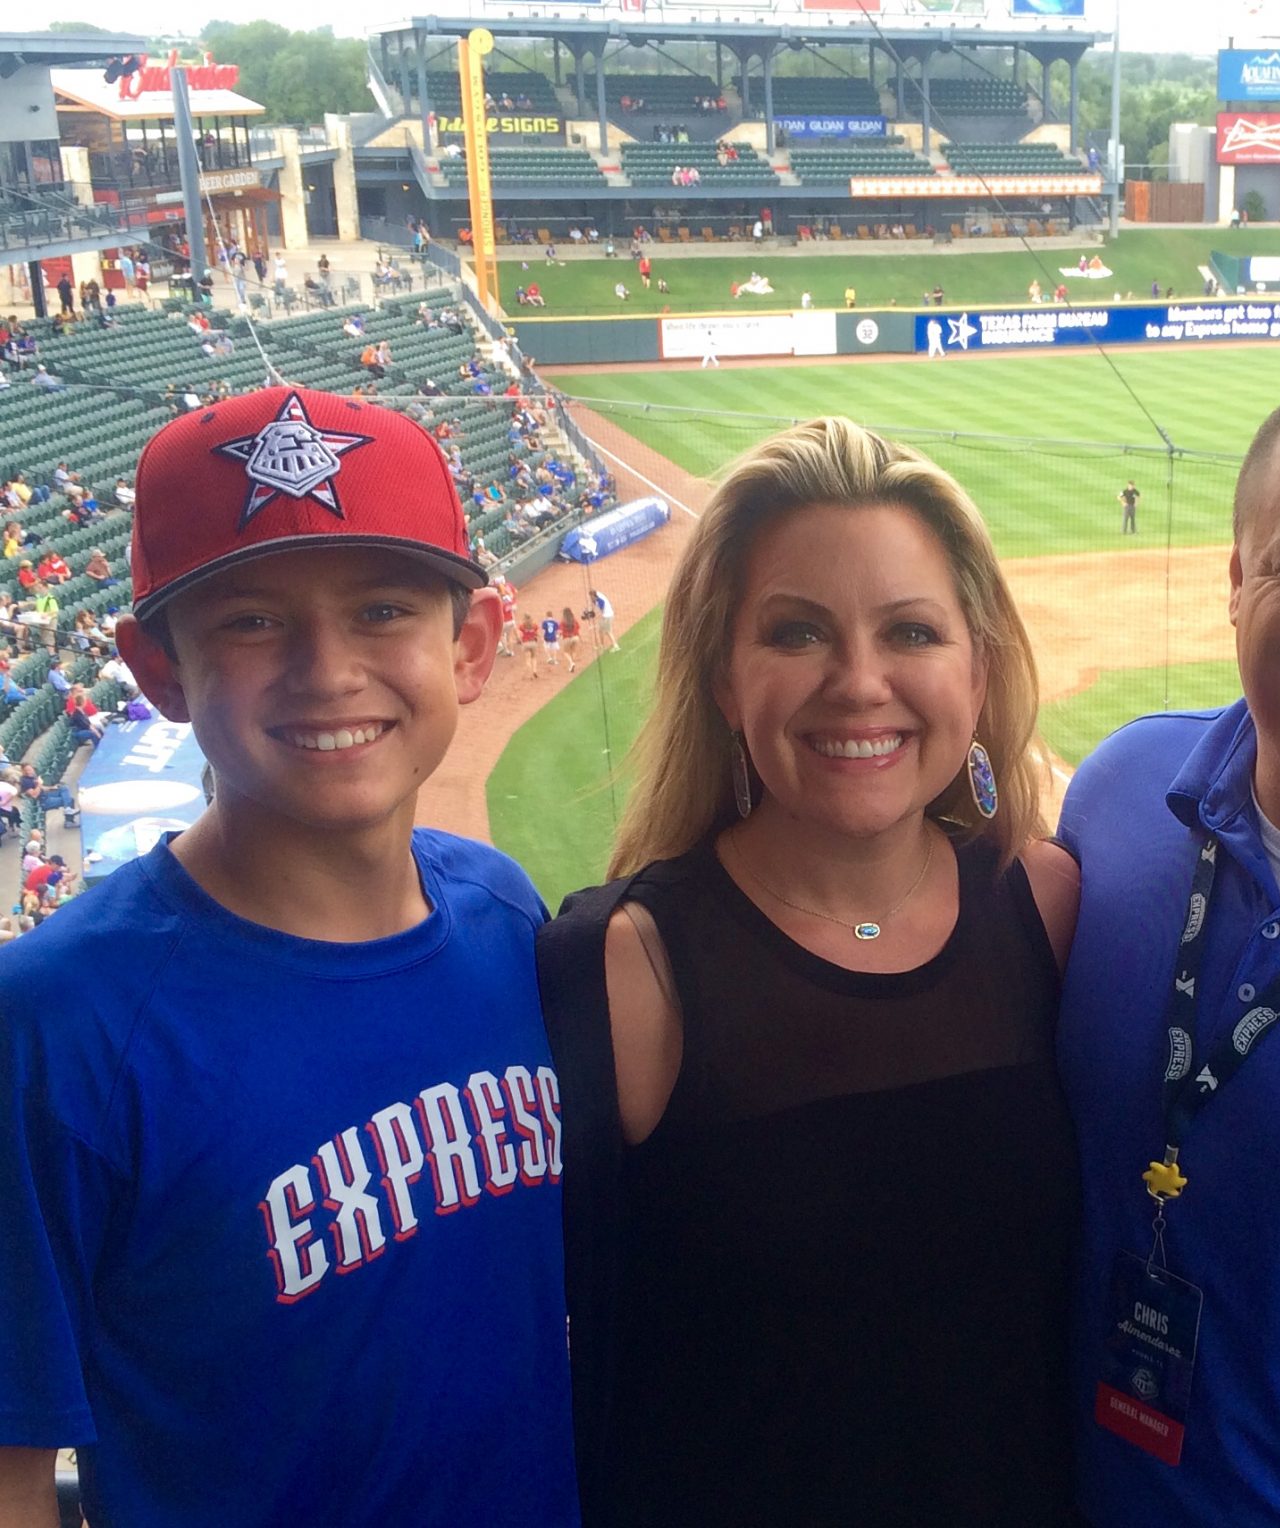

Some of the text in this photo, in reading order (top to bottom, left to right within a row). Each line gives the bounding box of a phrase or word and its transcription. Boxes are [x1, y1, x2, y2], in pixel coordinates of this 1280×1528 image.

[809, 120, 844, 131] GILDAN
[848, 120, 882, 131] GILDAN
[199, 171, 258, 191] BEER GARDEN
[980, 312, 1108, 329] TEXAS FARM BUREAU
[1146, 323, 1160, 337] to
[1161, 324, 1183, 340] any
[1185, 321, 1231, 338] Express
[1224, 305, 1245, 322] get
[1184, 895, 1202, 940] EXPRESS
[1236, 1010, 1275, 1052] EXPRESS
[1168, 1030, 1186, 1078] EXPRESS
[258, 1064, 564, 1305] EXPRESS
[1133, 1301, 1169, 1336] CHRIS
[1109, 1396, 1170, 1438] GENERAL MANAGER
